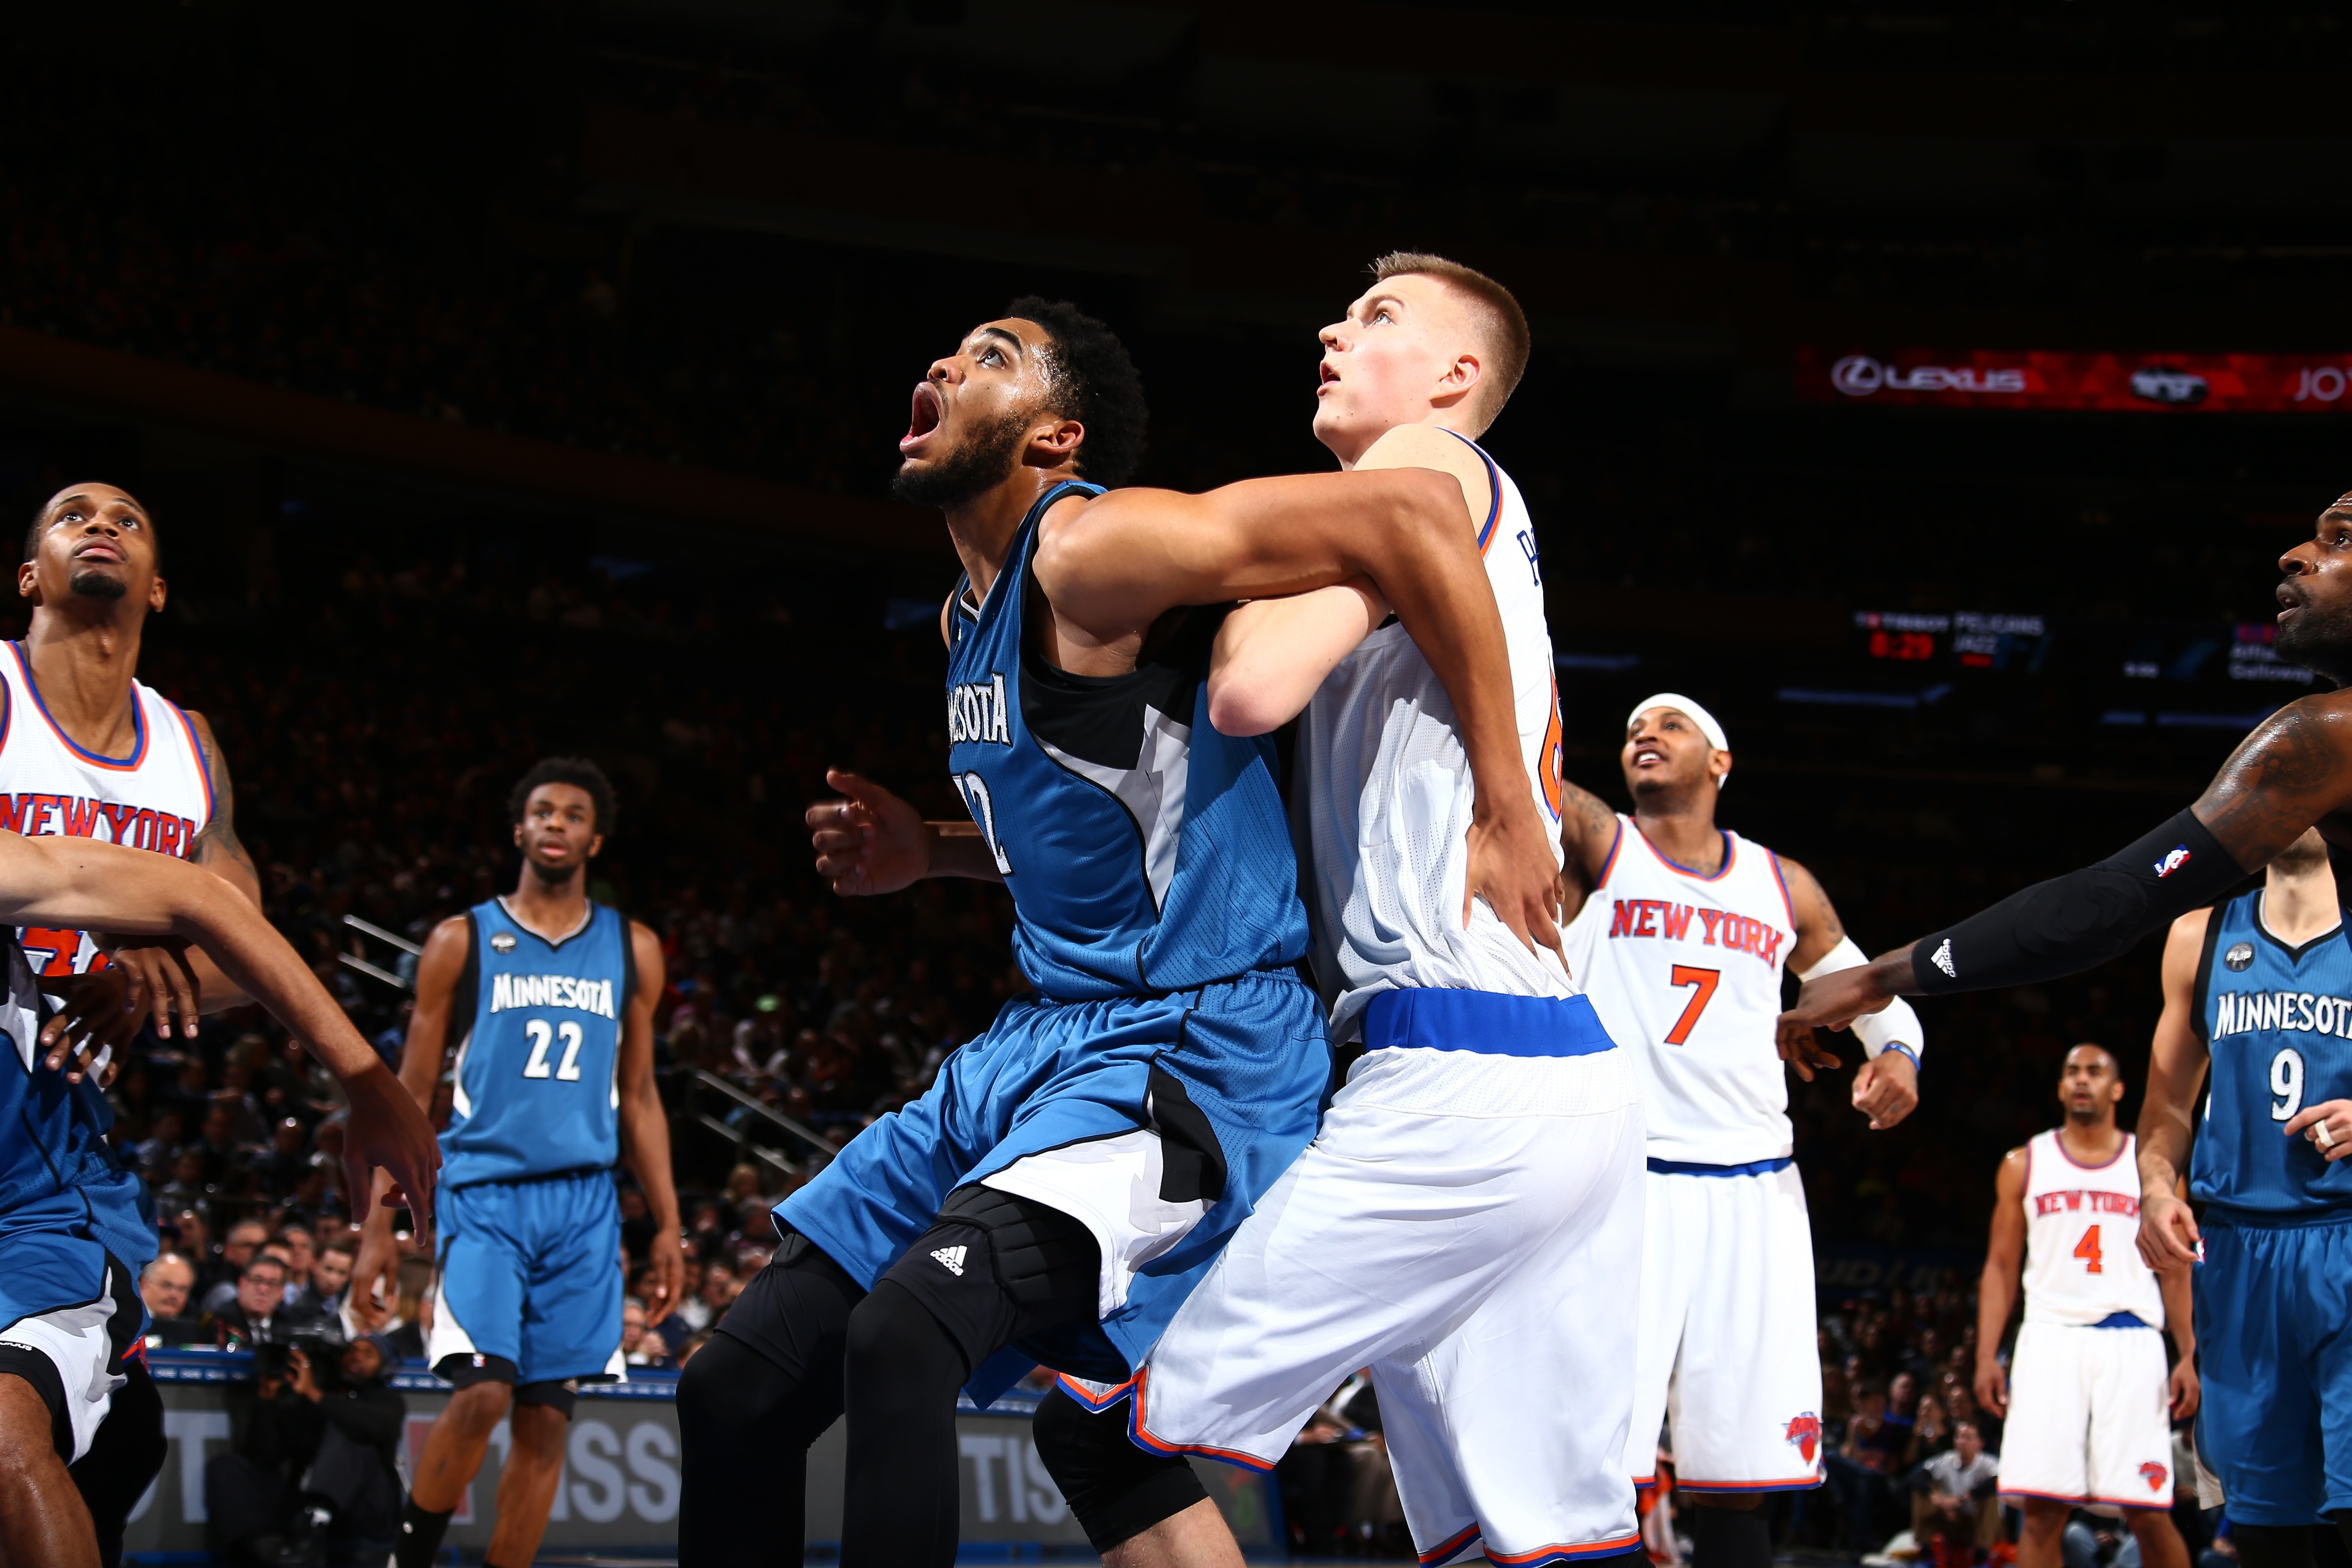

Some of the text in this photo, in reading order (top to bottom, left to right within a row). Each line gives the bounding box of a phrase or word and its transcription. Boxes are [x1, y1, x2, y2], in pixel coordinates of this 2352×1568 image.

[1885, 365, 2352, 402] LEXUS JO
[1609, 899, 1783, 969] NEW YORK
[1942, 938, 1958, 978] adidas
[2225, 950, 2252, 962] FLIP
[490, 972, 615, 1020] MINNESOTA
[1663, 964, 1720, 1045] 7
[523, 1019, 583, 1082] 22
[2270, 1048, 2304, 1121] 9
[2035, 1190, 2082, 1218] NEW
[930, 1250, 964, 1276] adidas
[2074, 1225, 2102, 1273] 4
